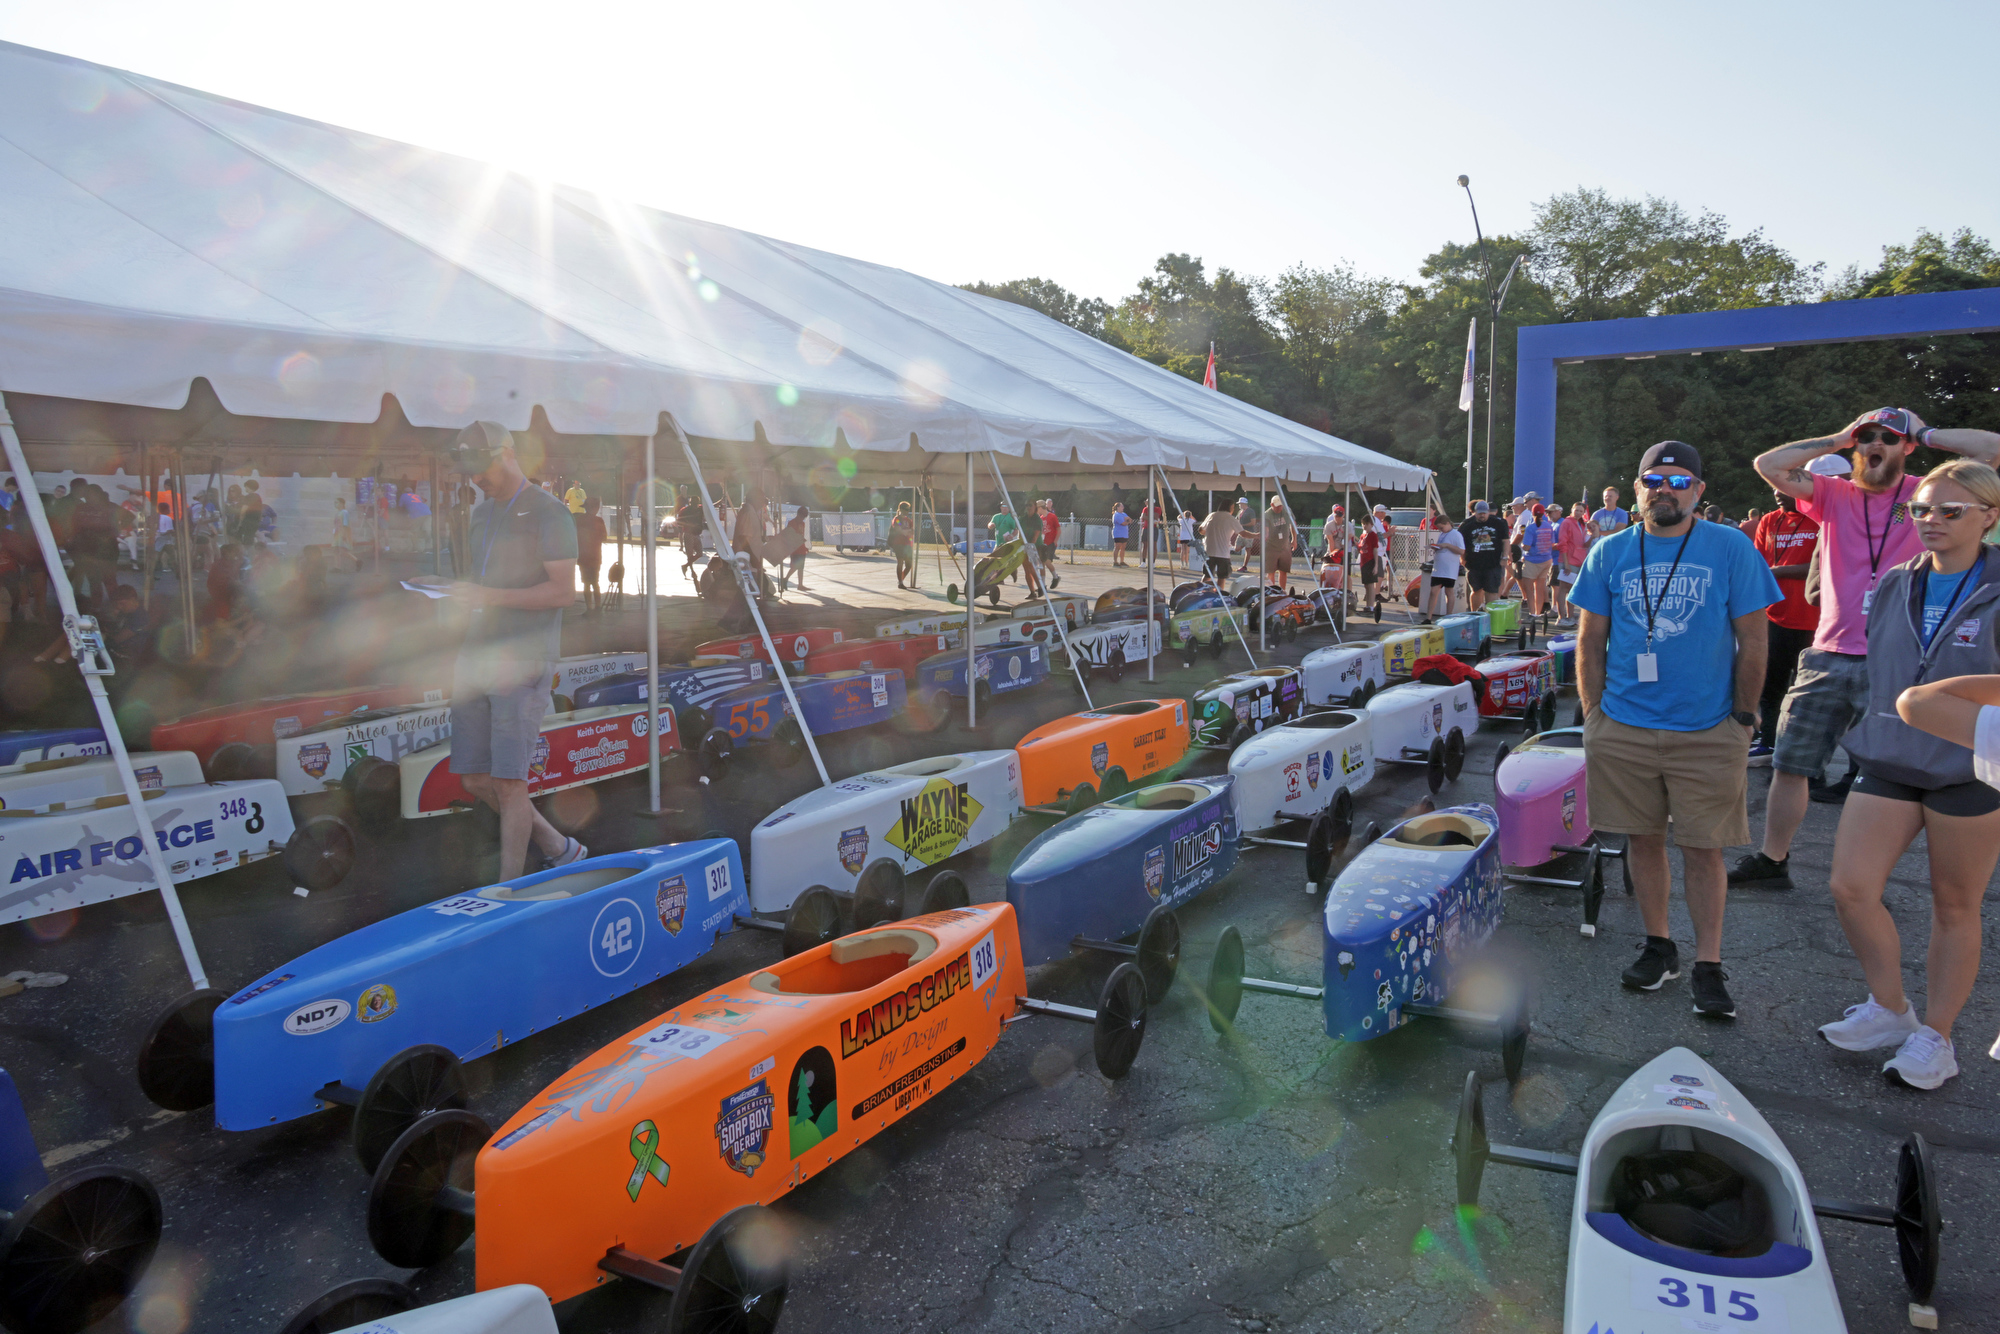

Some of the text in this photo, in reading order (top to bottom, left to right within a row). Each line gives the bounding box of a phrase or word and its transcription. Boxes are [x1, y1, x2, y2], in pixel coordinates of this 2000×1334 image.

[1776, 532, 1815, 541] WINNING
[1788, 539, 1804, 548] LIFE
[1671, 576, 1699, 599] BOX
[797, 641, 807, 651] M
[569, 662, 616, 677] PARKER YOO
[633, 717, 648, 733] 105
[728, 696, 770, 738] 55
[345, 725, 389, 742] Khloe
[577, 722, 618, 738] Keith Carlton
[568, 739, 629, 762] Golden Lion
[1343, 754, 1348, 768] R
[573, 751, 625, 775] Jewelers
[1283, 762, 1302, 775] SOCCER
[836, 783, 870, 793] 325
[1285, 791, 1302, 802] GOALIE
[220, 798, 247, 821] 348
[900, 782, 968, 843] WAYNE
[1170, 803, 1220, 841] ALEIGHA QUEEN
[841, 840, 867, 859] SOAP BOX
[904, 818, 969, 862] GARAGE DOOR
[919, 837, 958, 855] Sales & Service
[10, 848, 83, 884] AIR
[91, 819, 215, 867] FORCE
[847, 852, 861, 863] DERBY
[934, 852, 944, 860] Inc.
[711, 865, 728, 892] 312
[1173, 876, 1200, 899] Hampshire
[443, 897, 489, 912] 312
[660, 892, 685, 915] SOAP BOX
[665, 907, 680, 920] DERBY
[702, 913, 723, 932] STATEN
[601, 916, 632, 957] 42
[975, 941, 993, 979] 318
[983, 941, 1009, 1013] Daniel
[702, 994, 811, 1010] Daniel
[840, 951, 971, 1061] LANDSCAPE
[297, 1005, 338, 1026] ND7
[649, 1028, 711, 1050] 318
[878, 1017, 949, 1079] by Design
[751, 1063, 764, 1078] 213
[862, 1045, 959, 1113] BRIAN FREIDENSTINE
[730, 1085, 760, 1106] FirstEnergy
[895, 1076, 932, 1111] LIBERTY, NY
[717, 1097, 772, 1132] ALL-AMERICAN
[721, 1104, 770, 1151] SOAP BOX
[734, 1129, 760, 1155] DERBY
[1657, 1277, 1760, 1322] 315
